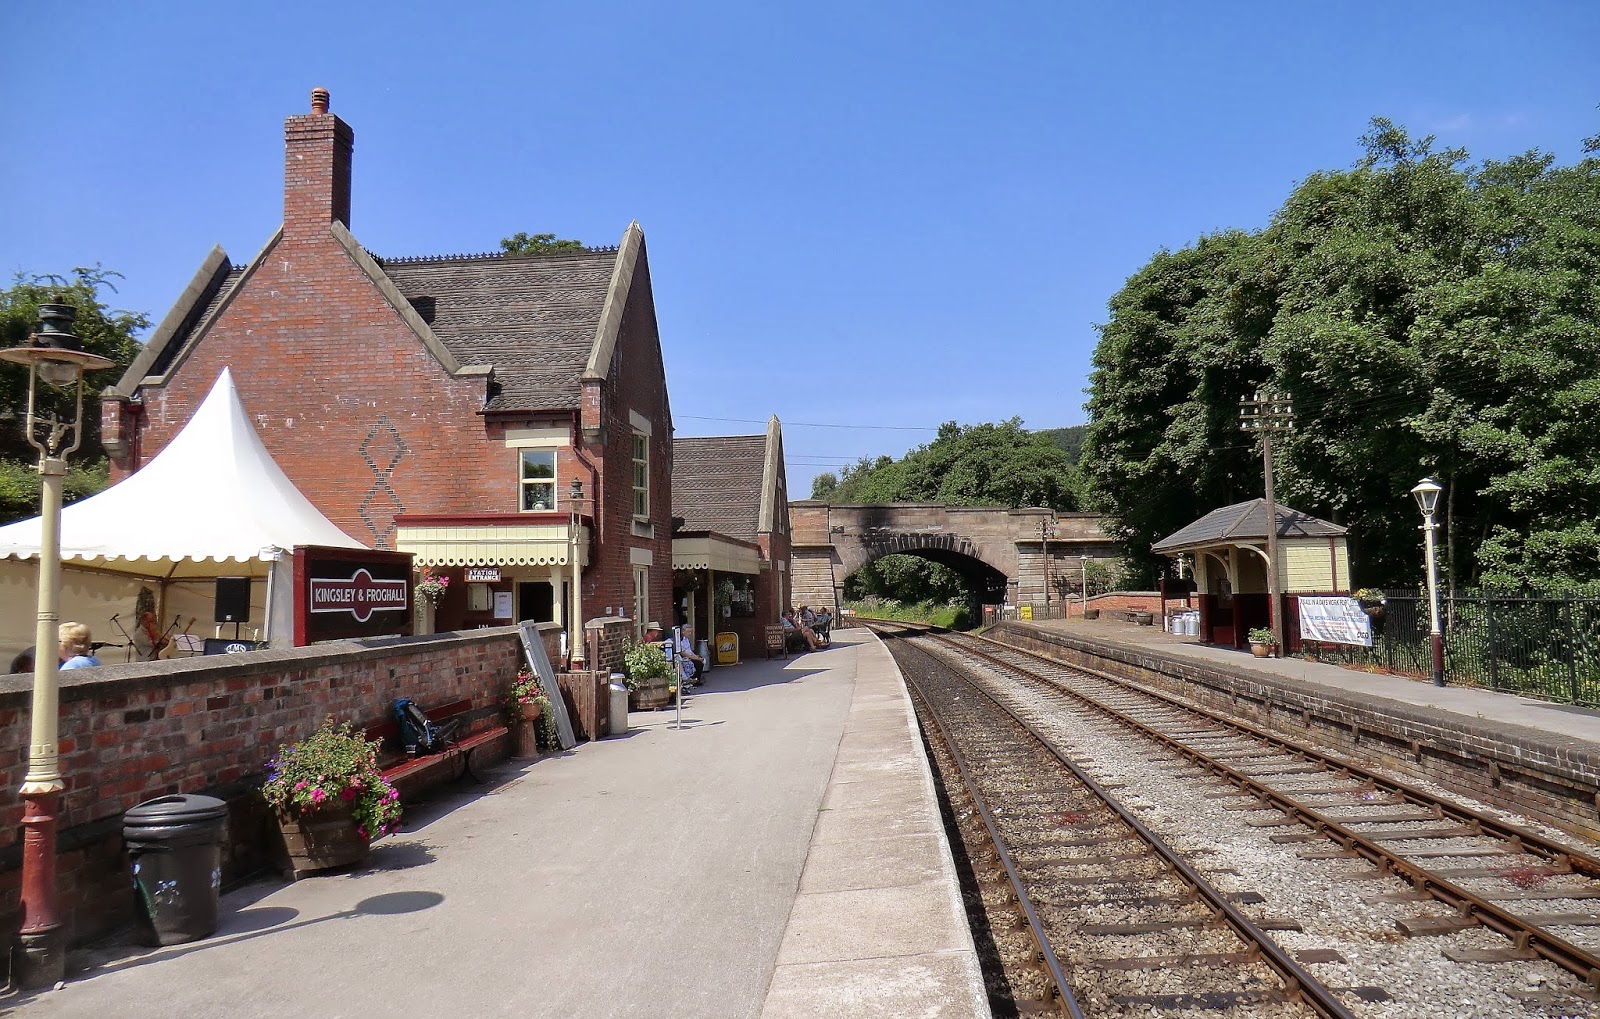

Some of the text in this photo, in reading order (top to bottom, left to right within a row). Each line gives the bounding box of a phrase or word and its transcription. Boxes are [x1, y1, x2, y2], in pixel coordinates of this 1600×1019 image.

[315, 588, 405, 602] KINGSLEY & FROGHALL
